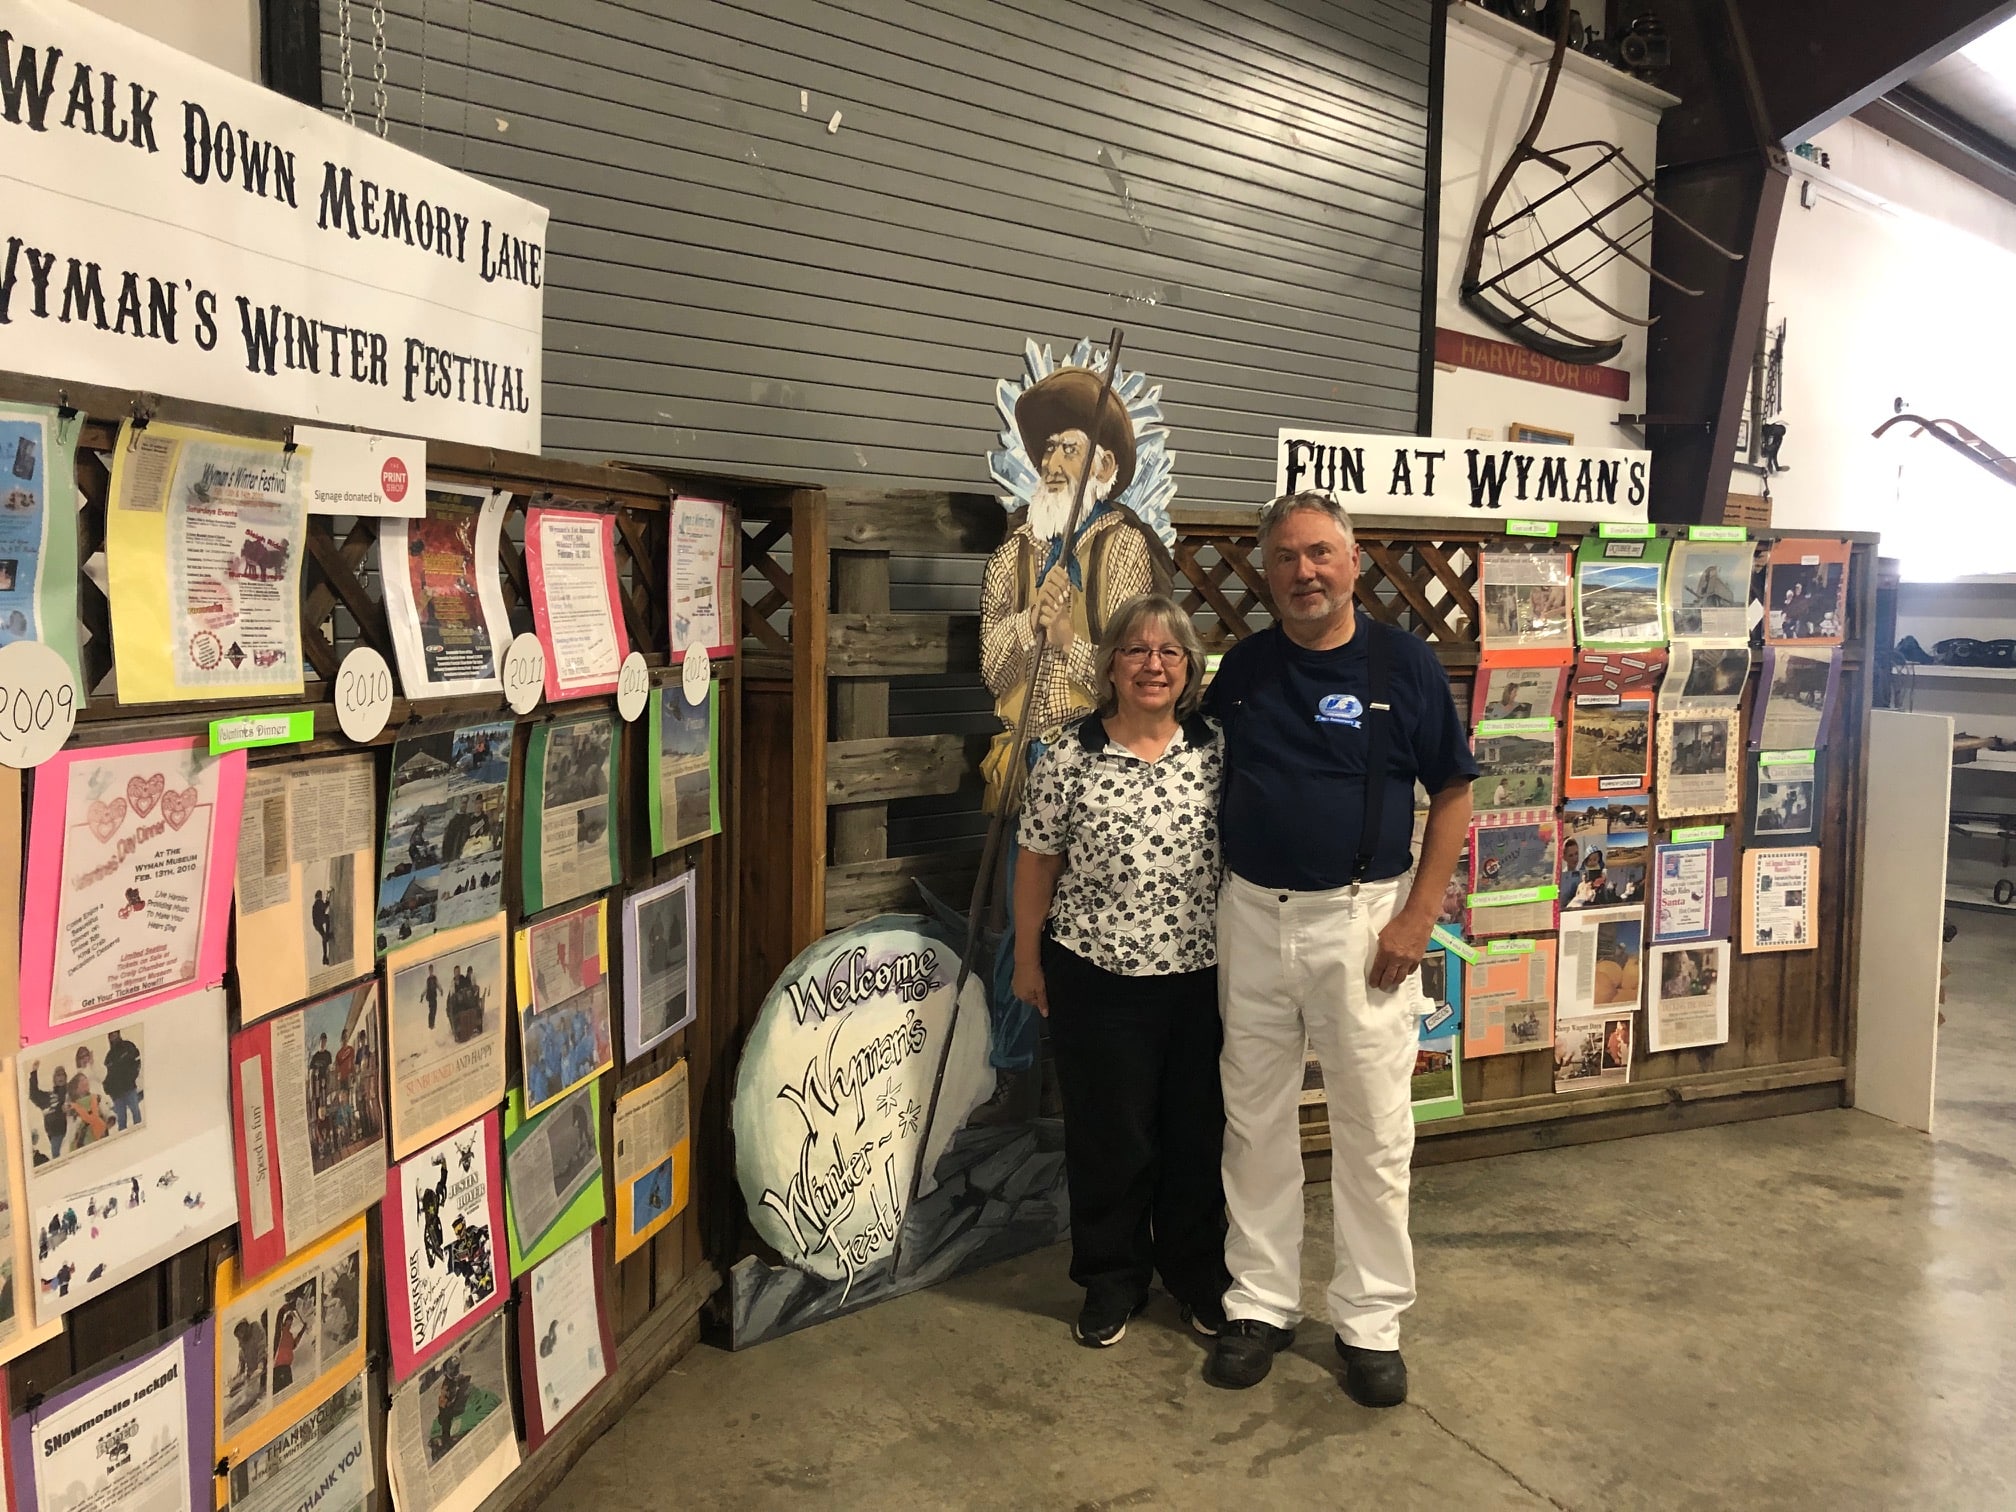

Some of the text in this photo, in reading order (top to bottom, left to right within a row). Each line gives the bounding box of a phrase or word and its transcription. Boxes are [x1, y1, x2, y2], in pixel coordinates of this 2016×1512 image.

[0, 30, 542, 290] WALK DOWN MEMORY LANE
[235, 296, 388, 387] WINTER
[404, 337, 530, 414] FESTIVAL
[1461, 338, 1580, 387] HARVESTOR
[235, 466, 259, 491] Winter
[258, 469, 287, 495] Festival
[383, 472, 407, 483] PRINT
[386, 484, 404, 493] SHOP
[1284, 439, 1646, 509] FUN AT WYMAN'S
[314, 489, 383, 505] Signage donated by
[510, 657, 544, 690] 2011
[685, 655, 709, 683] 2013
[343, 670, 388, 712] 2010
[257, 723, 286, 736] Dinner
[136, 821, 166, 846] Dinner
[135, 854, 198, 872] WYMAN MUSEUM
[154, 848, 181, 859] AT THE
[134, 872, 152, 883] FEB.
[176, 863, 196, 875] 2010
[1661, 898, 1686, 908] Santa
[81, 995, 95, 1008] Get
[97, 990, 113, 1004] Your
[115, 984, 141, 1001] Tickets
[784, 945, 939, 1026] Welcome
[776, 1009, 928, 1136] Wyman's
[255, 1132, 263, 1144] is
[448, 1170, 479, 1200] JUSTIN
[456, 1183, 486, 1212] HOYER
[811, 1153, 904, 1308] Fest!
[133, 1363, 179, 1404] Jackpot
[266, 1421, 309, 1461] THANK
[296, 1441, 363, 1512] THANK YOU
